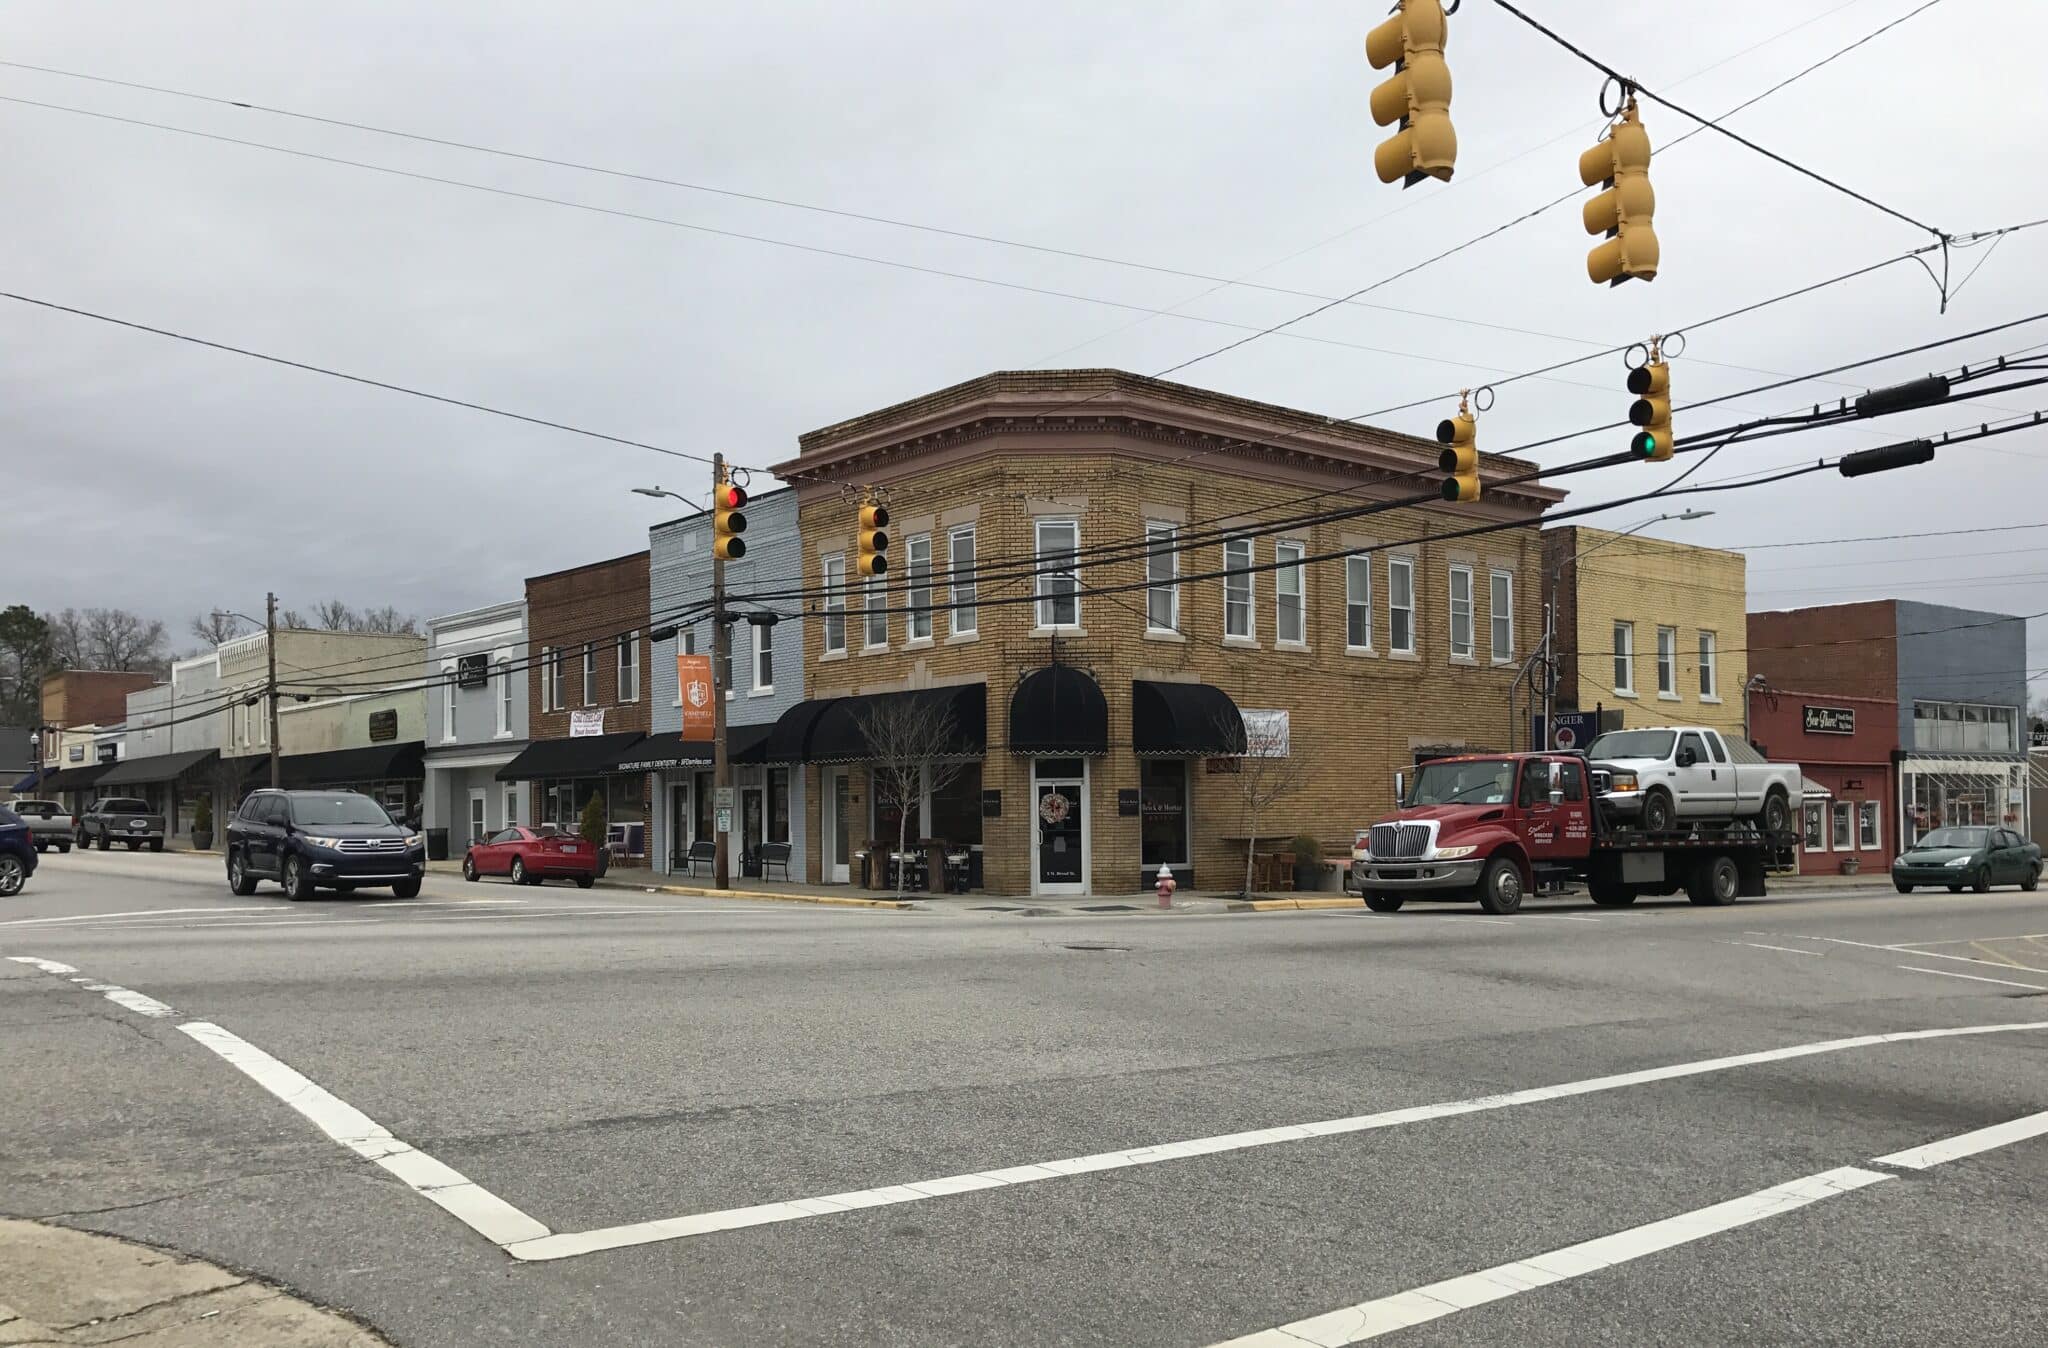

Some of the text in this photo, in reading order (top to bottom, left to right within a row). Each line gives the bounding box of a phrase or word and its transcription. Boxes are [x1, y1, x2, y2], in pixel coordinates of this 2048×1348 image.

[1554, 715, 1584, 725] NGIER
[618, 762, 640, 770] SIGNATURE
[640, 761, 654, 769] FAMILY
[654, 759, 677, 768] DENTISTRY
